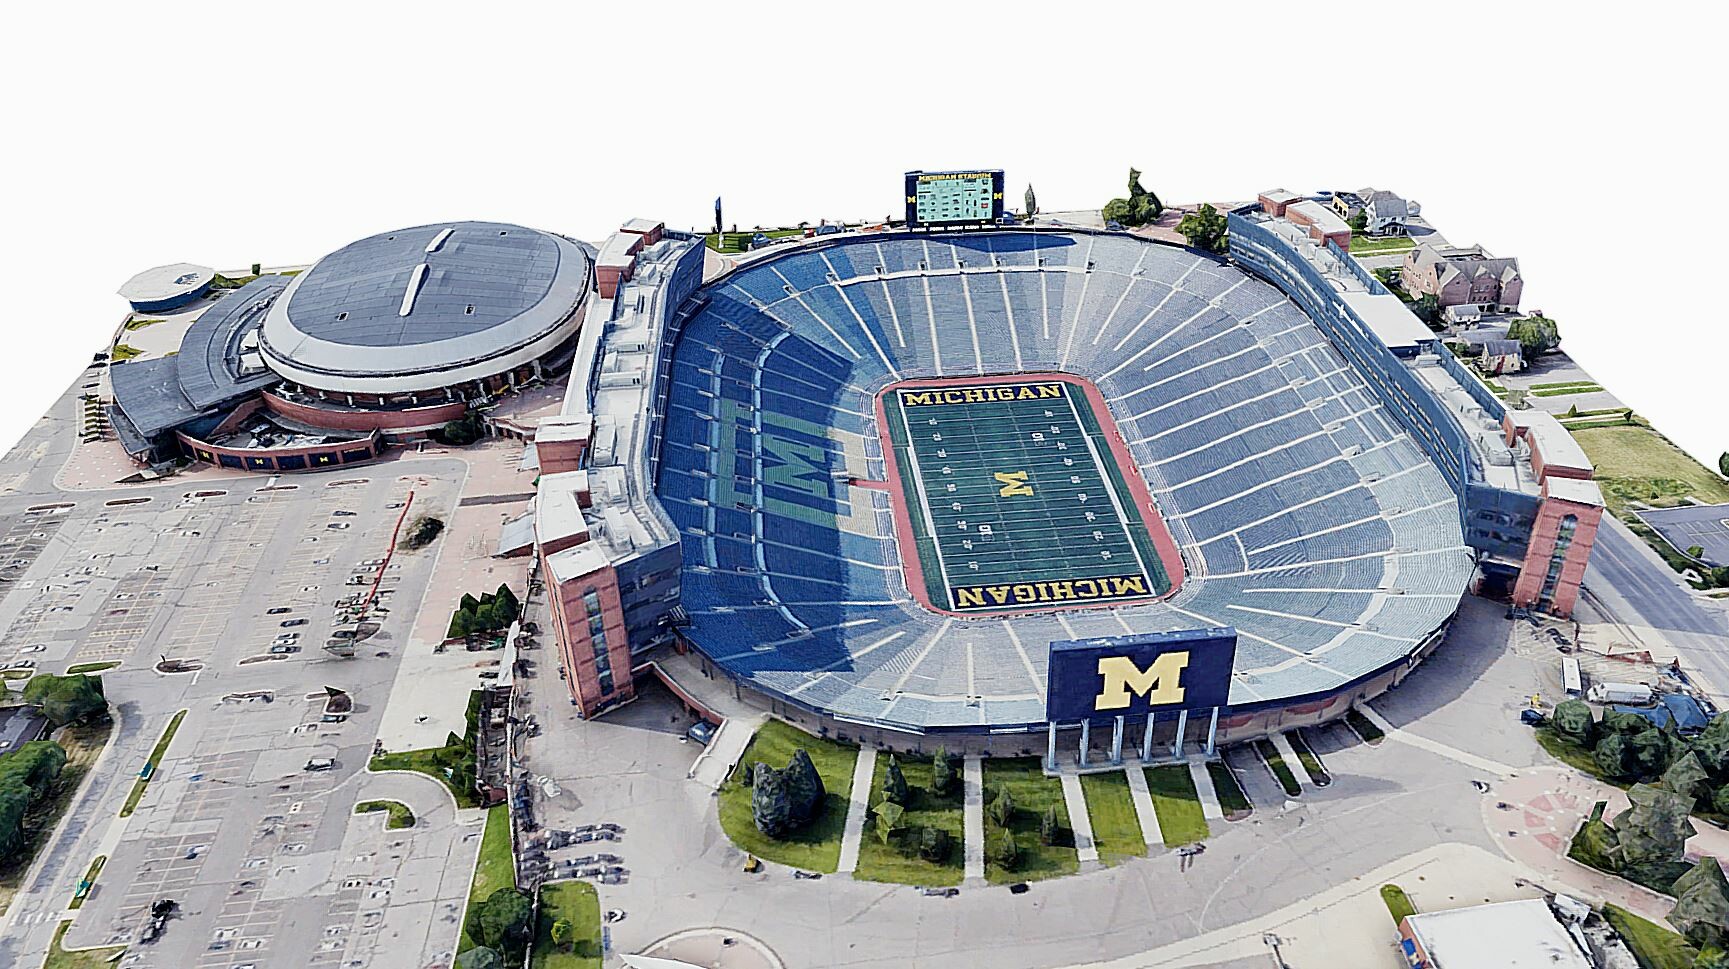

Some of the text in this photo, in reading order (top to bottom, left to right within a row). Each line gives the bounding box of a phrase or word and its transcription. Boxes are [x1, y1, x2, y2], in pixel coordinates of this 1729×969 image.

[904, 385, 1061, 406] MICHIGAN
[994, 471, 1034, 497] M
[957, 576, 1148, 607] MICHIGAN
[1095, 651, 1189, 710] M
